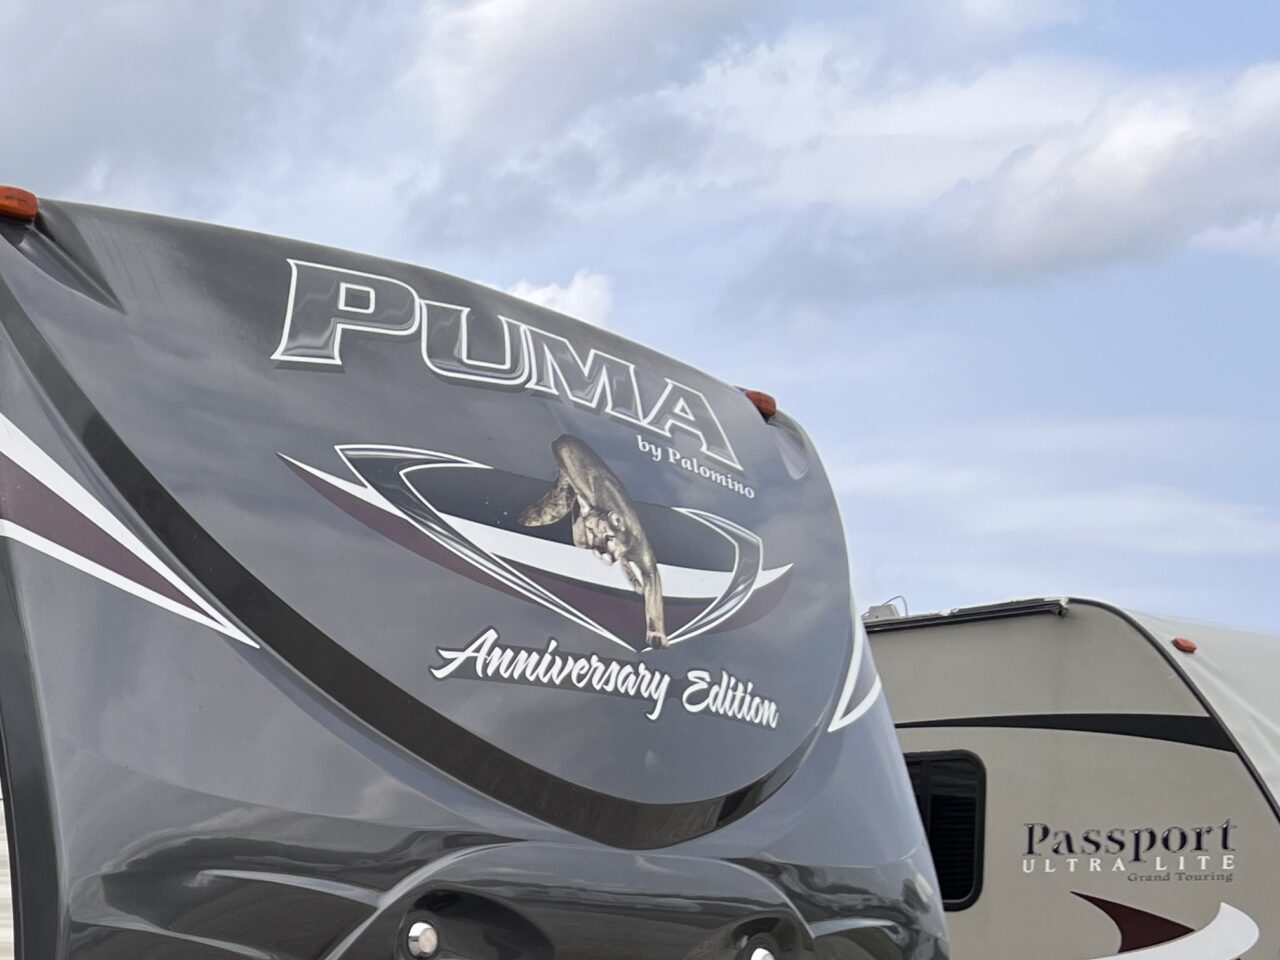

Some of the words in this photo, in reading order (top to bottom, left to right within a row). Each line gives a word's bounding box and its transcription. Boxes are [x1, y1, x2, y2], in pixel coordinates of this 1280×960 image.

[271, 259, 743, 470] PUMA
[636, 435, 662, 461] by
[667, 446, 755, 499] Palomino
[430, 628, 671, 720] Anniversary
[682, 669, 778, 728] Edition
[1022, 858, 1126, 873] ULTRA
[1155, 855, 1235, 871] LITE
[1023, 818, 1238, 863] Passport
[1127, 872, 1170, 882] Grand
[1174, 871, 1234, 883] Touring
